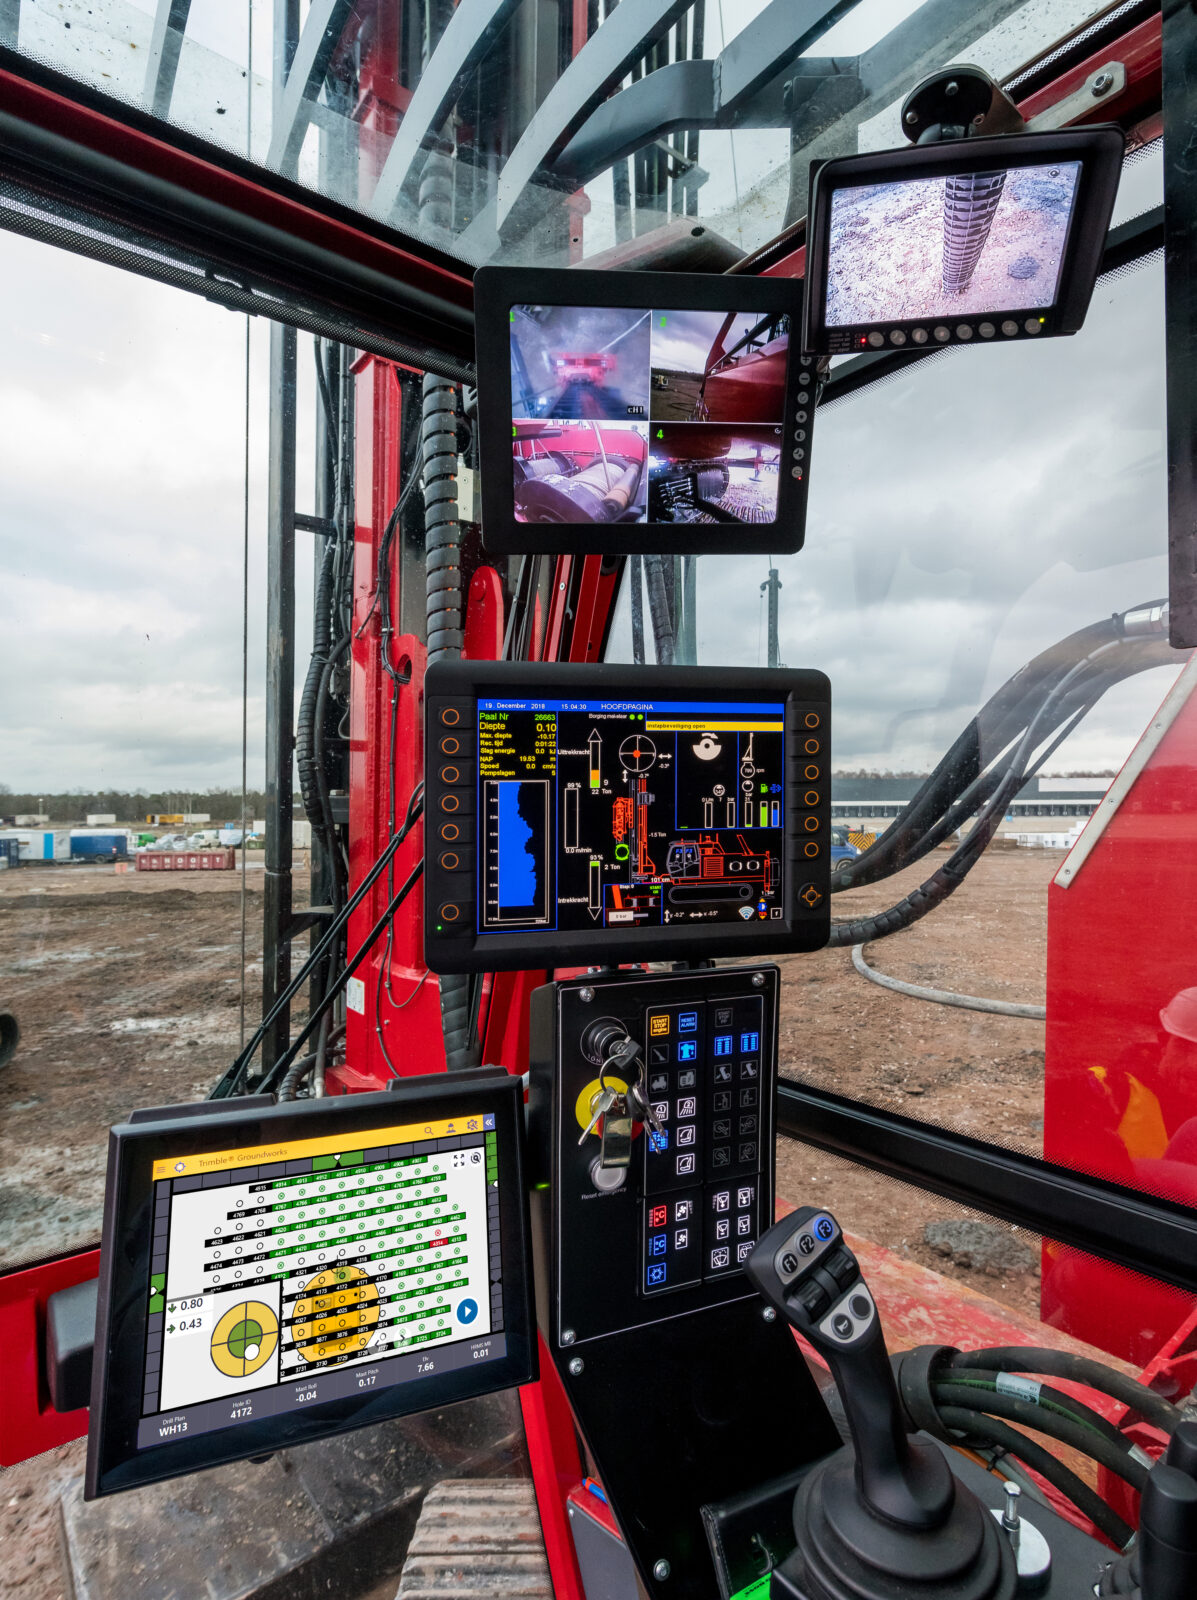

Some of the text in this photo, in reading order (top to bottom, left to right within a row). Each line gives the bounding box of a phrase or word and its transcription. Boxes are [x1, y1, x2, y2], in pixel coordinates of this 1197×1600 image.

[657, 429, 664, 439] 4
[480, 723, 557, 732] Diepte 0.10
[237, 1149, 287, 1161] Groundworks
[818, 1221, 832, 1237] F3
[801, 1237, 814, 1253] F2
[784, 1256, 797, 1272] F1
[180, 1298, 203, 1311] 0.80
[179, 1318, 202, 1331] 0.43
[473, 1348, 489, 1359] 0.01
[418, 1362, 434, 1373] 7.66
[358, 1376, 376, 1387] 0.17
[296, 1390, 317, 1403] -0.04
[230, 1407, 252, 1419] 4172
[159, 1422, 188, 1437] WH13
